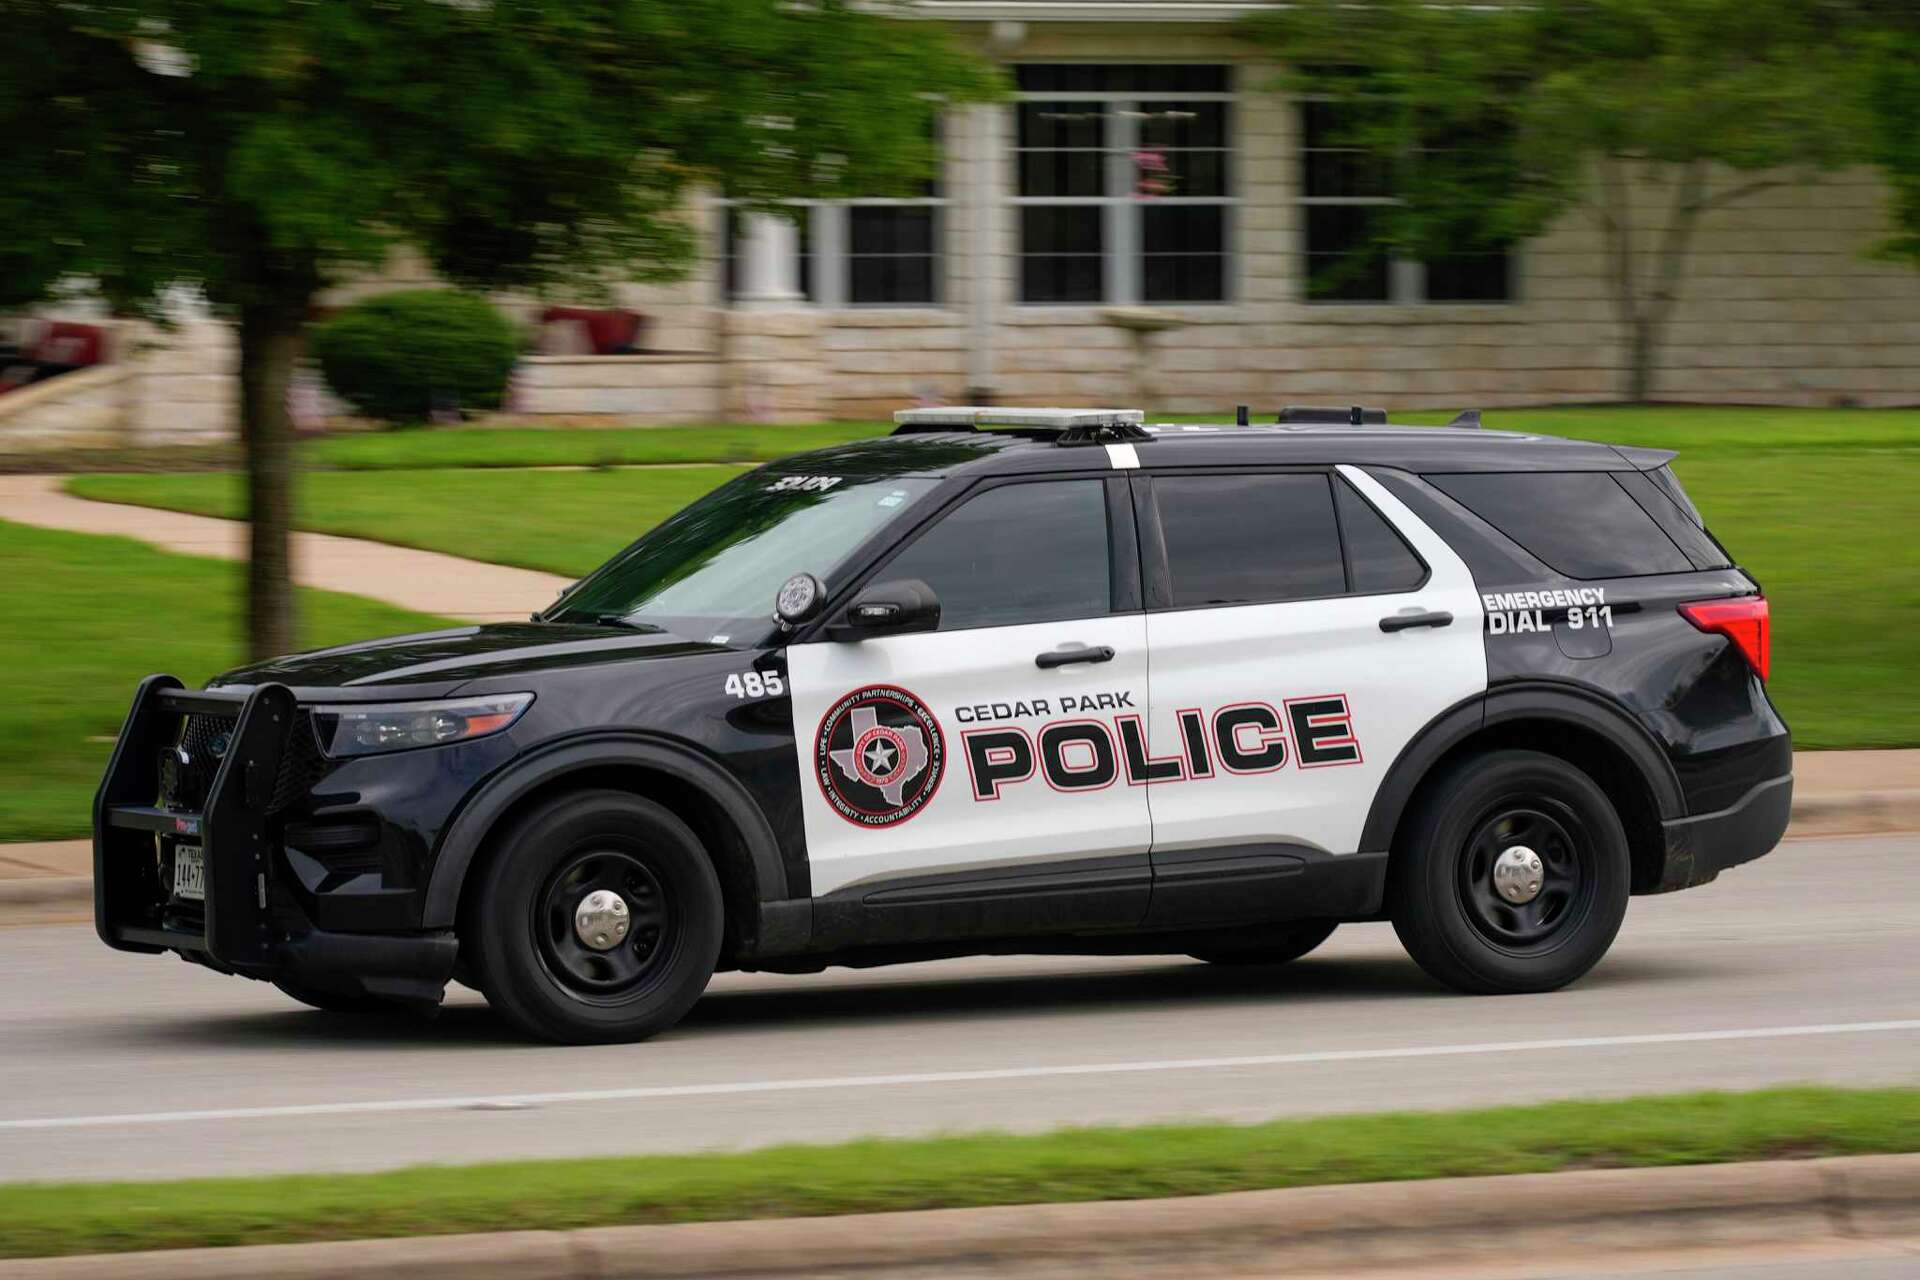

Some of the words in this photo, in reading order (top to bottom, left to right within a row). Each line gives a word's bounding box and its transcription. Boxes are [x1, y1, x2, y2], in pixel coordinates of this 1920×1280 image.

[1482, 587, 1605, 611] EMERGENCY
[1488, 609, 1551, 635] DIAL
[1567, 606, 1614, 629] 911
[725, 670, 783, 698] 485
[825, 695, 860, 731] COMMUNITY
[862, 689, 914, 706] PARTNERSHIPS
[954, 699, 1051, 723] CEDAR
[1059, 691, 1136, 714] PARK
[917, 708, 940, 753] EXCELLENCE
[960, 693, 1363, 801] POLICE
[829, 790, 859, 818] INTEGRITY
[864, 797, 923, 824] ACCOUNTABILITY
